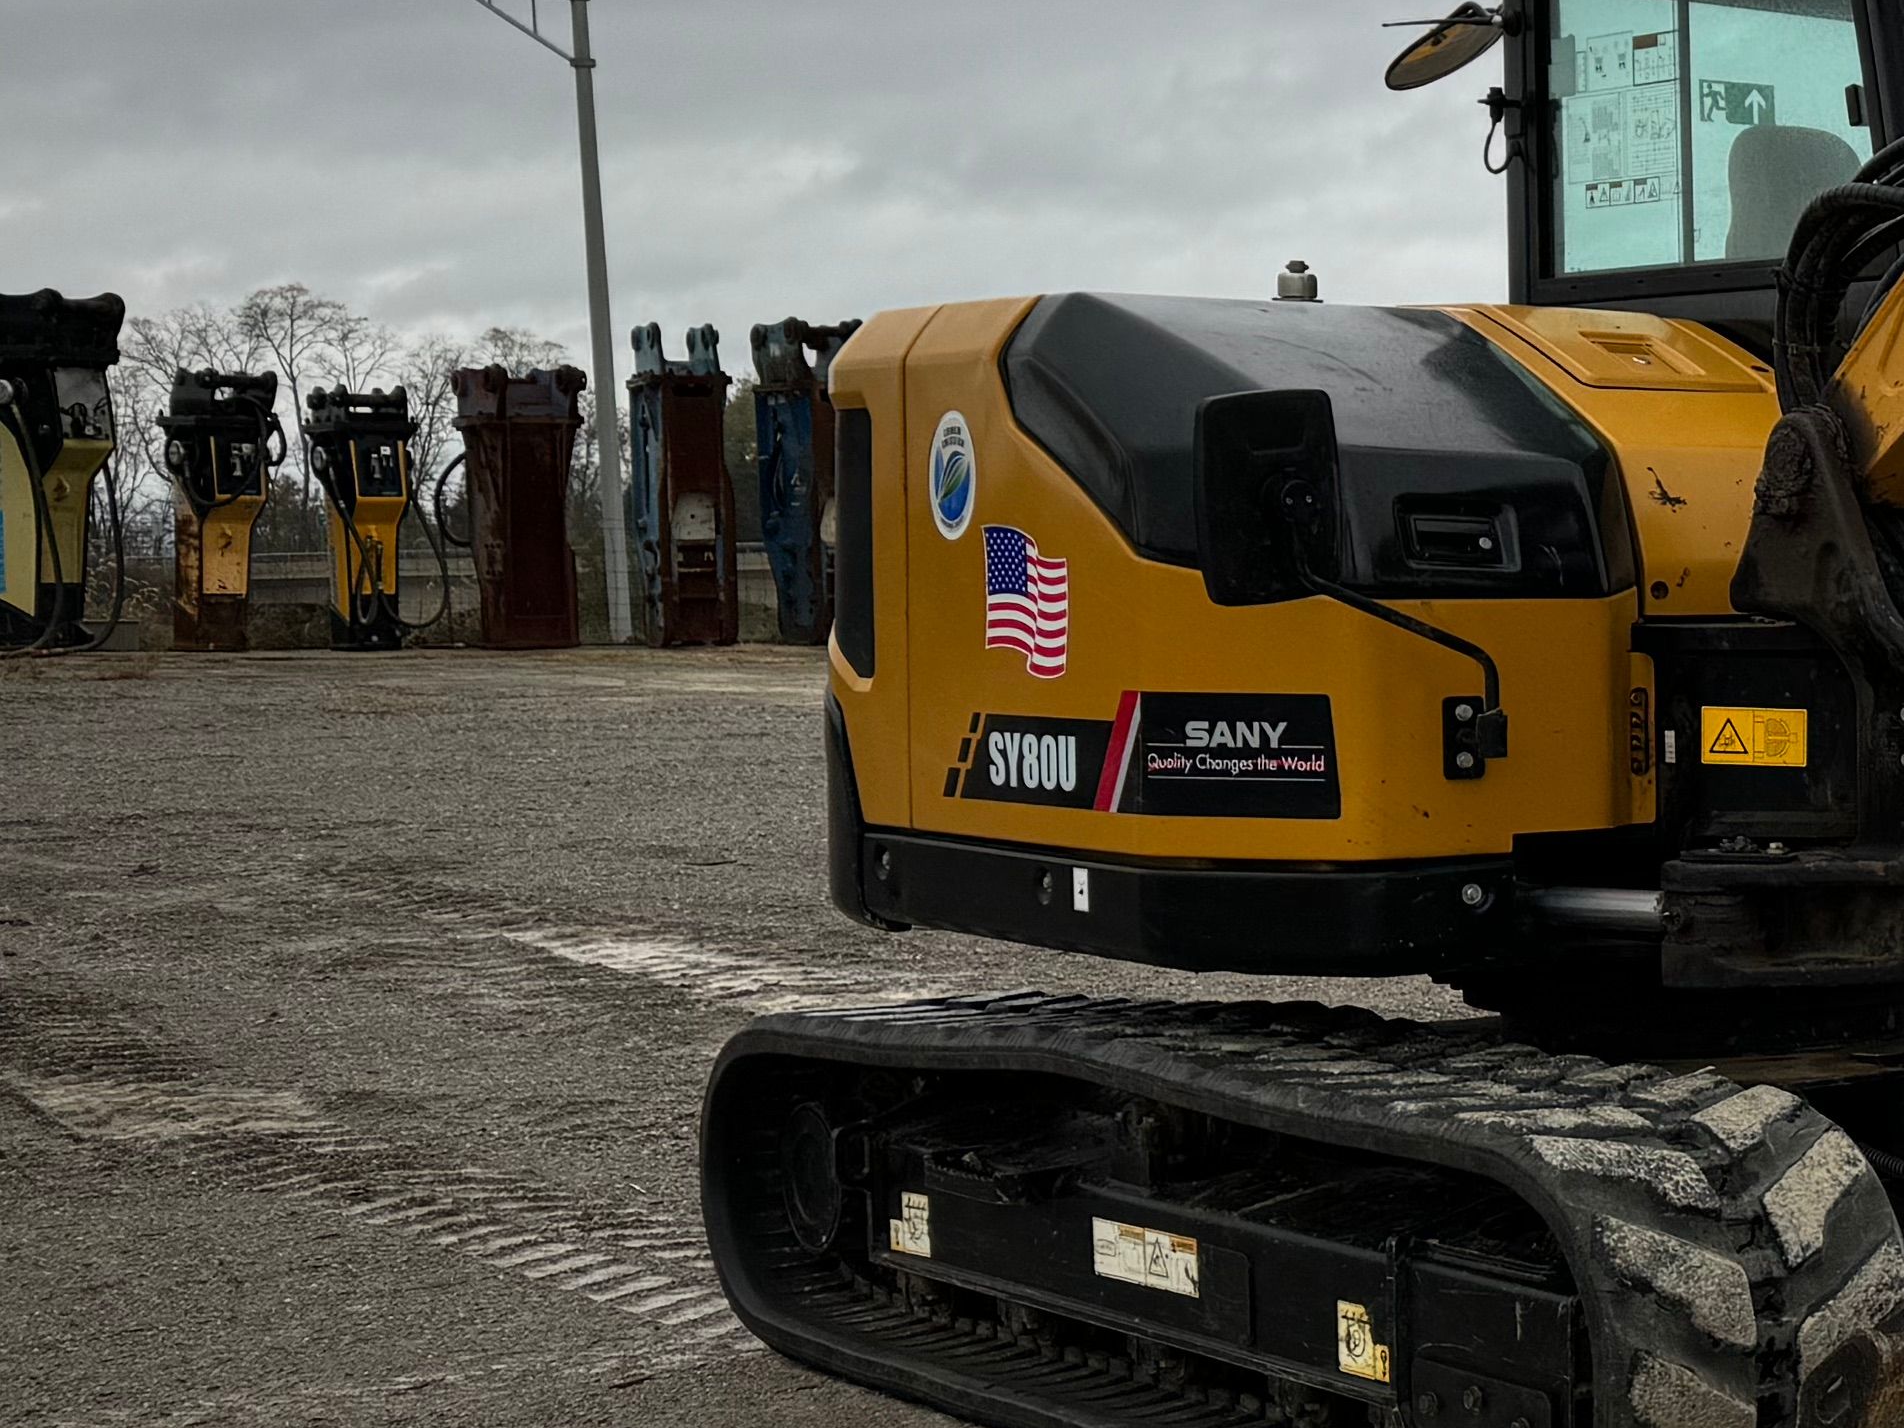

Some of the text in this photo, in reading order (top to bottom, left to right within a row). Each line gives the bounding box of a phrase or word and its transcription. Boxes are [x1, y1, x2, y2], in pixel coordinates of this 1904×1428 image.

[1185, 721, 1287, 748] SANY
[989, 731, 1077, 792] SY80U
[1147, 752, 1326, 776] Quality Changes the World
